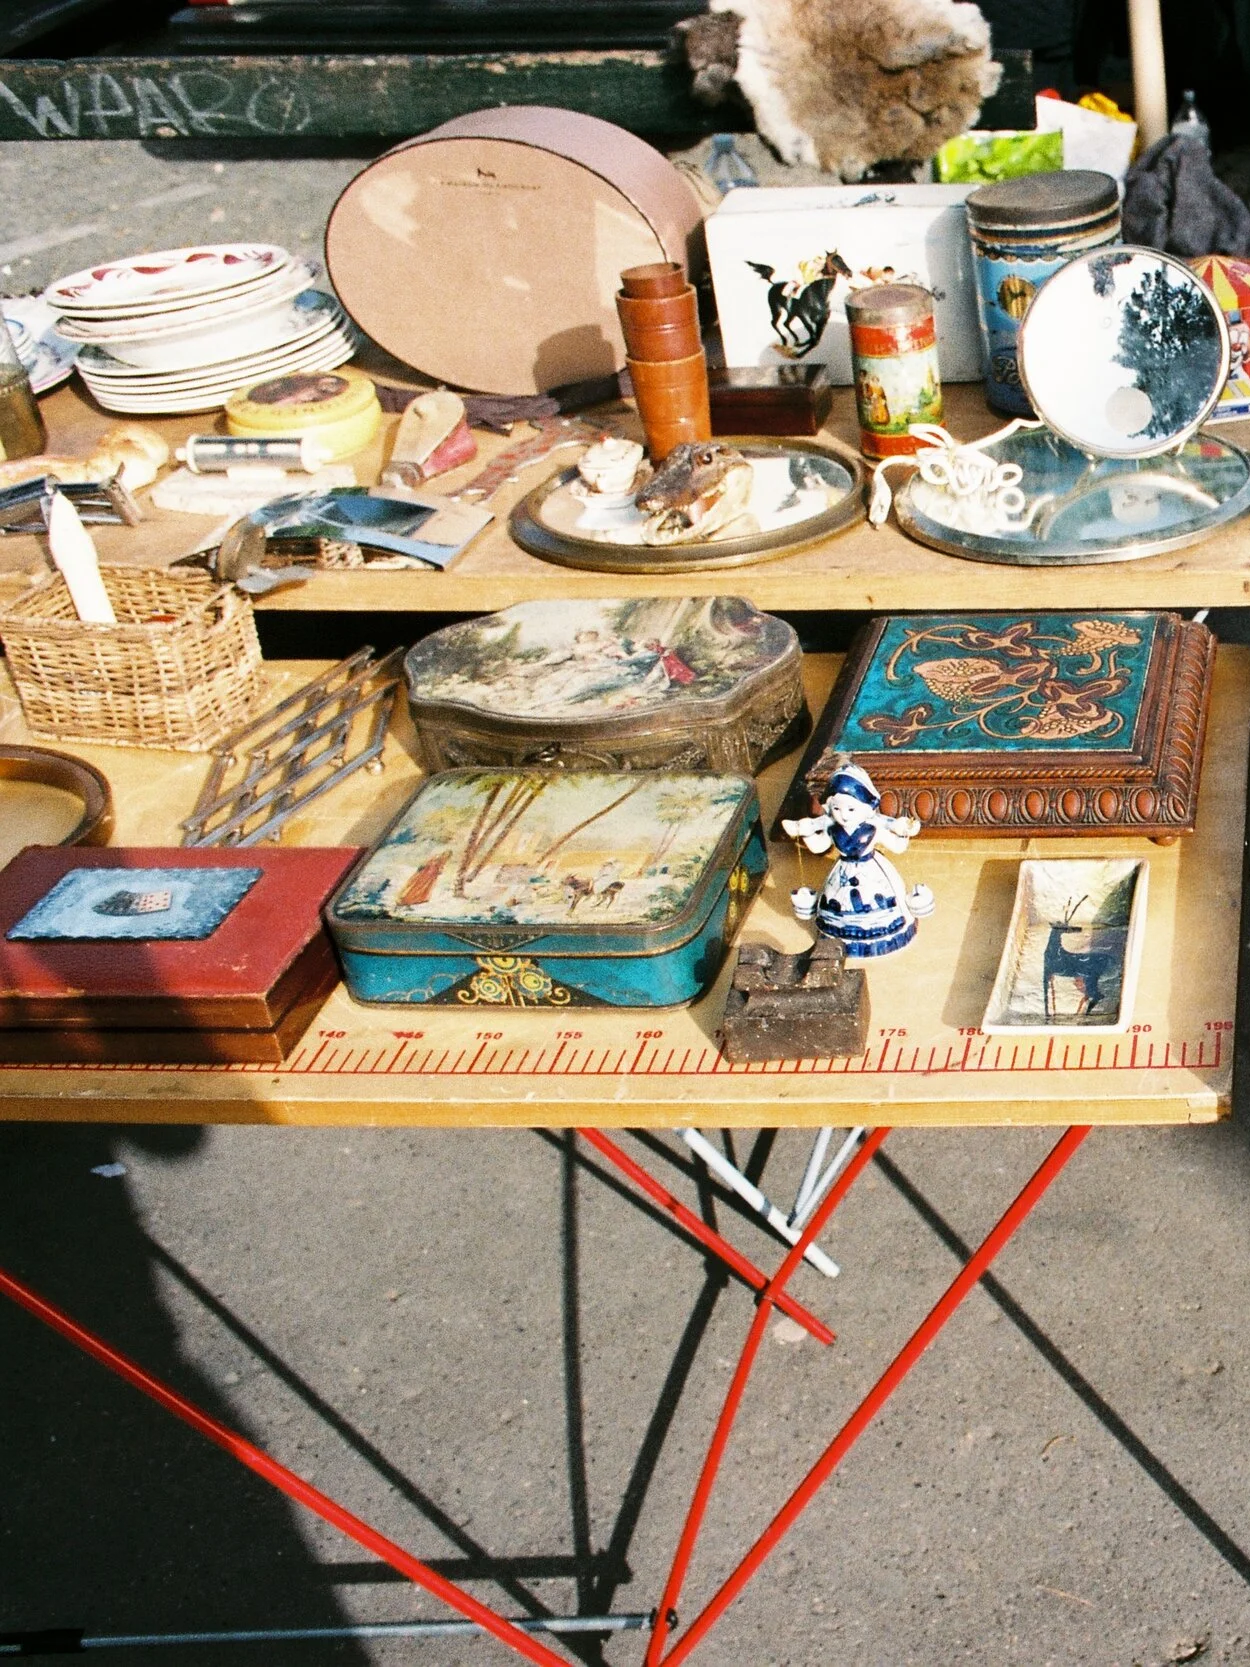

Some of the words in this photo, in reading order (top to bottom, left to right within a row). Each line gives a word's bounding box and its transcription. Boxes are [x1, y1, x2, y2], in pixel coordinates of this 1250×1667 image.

[318, 1030, 347, 1039] 140
[475, 1031, 504, 1040] 150
[555, 1031, 584, 1040] 155
[634, 1030, 664, 1040] 160
[878, 1028, 907, 1037] 175
[1126, 1024, 1152, 1034] 90
[1204, 1021, 1234, 1031] 195
